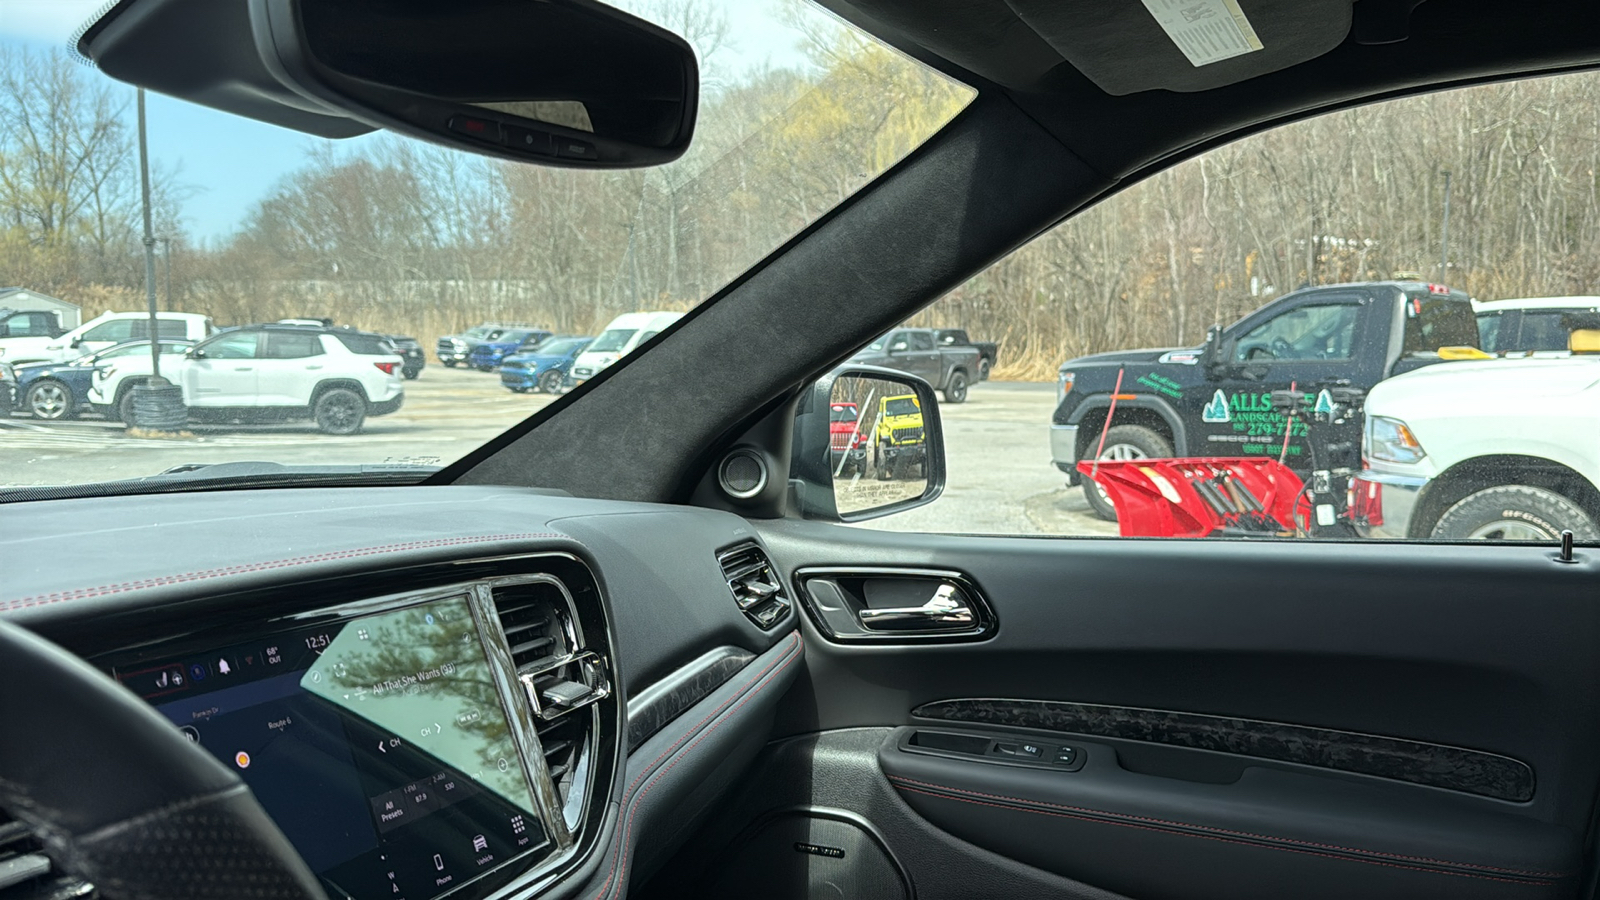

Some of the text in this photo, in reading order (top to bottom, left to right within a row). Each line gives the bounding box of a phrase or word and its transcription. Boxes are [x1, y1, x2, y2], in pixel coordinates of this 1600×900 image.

[305, 633, 331, 649] 12:51
[268, 655, 282, 664] OUT
[372, 662, 456, 695] All That She Wants (93)
[267, 720, 287, 730] Route
[420, 726, 431, 737] CH
[389, 738, 401, 748] CH
[385, 801, 394, 811] All
[381, 808, 404, 823] Presets
[518, 836, 530, 847] Apps
[476, 853, 494, 866] Vehicle
[436, 874, 453, 886] Phone
